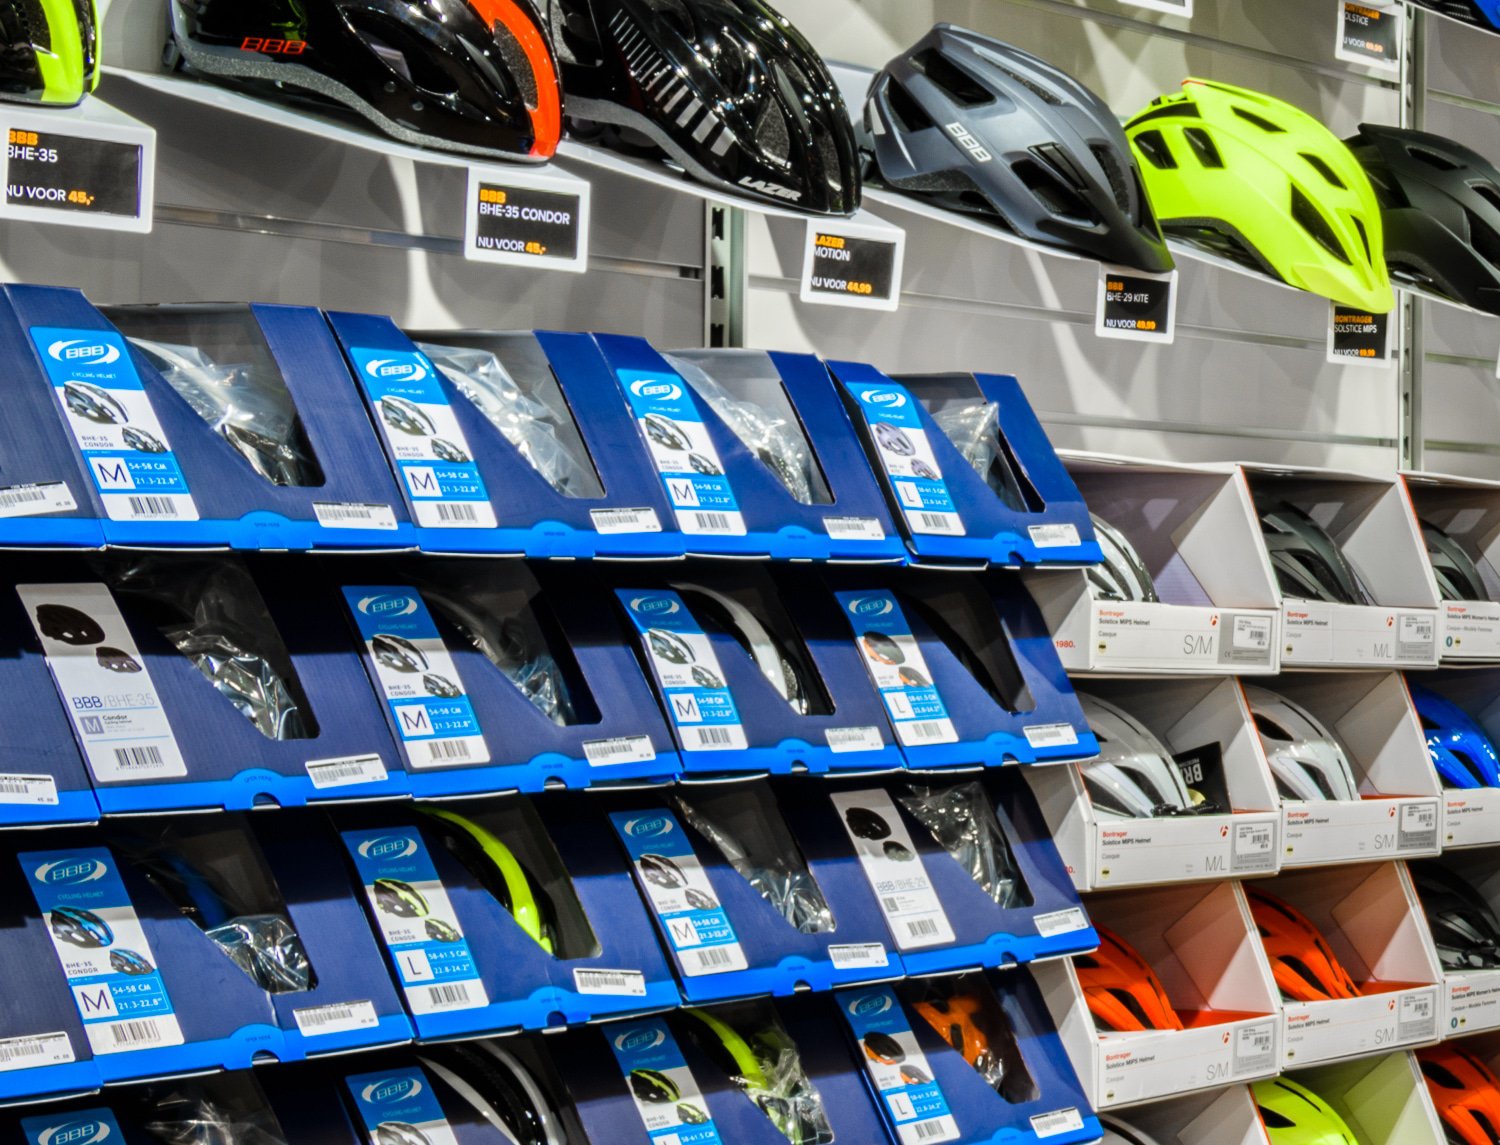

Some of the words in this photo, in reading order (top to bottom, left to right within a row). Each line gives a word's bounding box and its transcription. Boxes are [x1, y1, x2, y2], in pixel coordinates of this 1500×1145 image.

[241, 37, 307, 55] BBB
[1349, 38, 1365, 48] VOOR
[945, 122, 992, 163] BBB
[8, 145, 58, 163] BHE-35
[6, 185, 23, 197] NU
[27, 187, 66, 201] VOOR
[68, 191, 94, 206] 45,-
[738, 176, 801, 201] LAZER
[480, 189, 506, 204] BBB
[479, 202, 519, 219] BHE-35
[521, 208, 570, 224] CONDOR
[478, 237, 493, 248] NU
[495, 239, 525, 251] VOOR
[815, 235, 844, 249] LAZER
[814, 247, 850, 261] MOTION
[823, 278, 846, 290] VOOR
[1107, 282, 1124, 290] BBB
[1106, 293, 1132, 302] BHE-29
[1134, 294, 1149, 303] KITE
[1106, 319, 1116, 327] NU
[1117, 320, 1136, 328] VOOR
[1335, 324, 1362, 333] SOLSTICE
[1363, 325, 1377, 333] MIPS
[66, 345, 104, 359] BBB
[381, 364, 412, 376] BBB
[643, 385, 670, 395] BBB
[872, 394, 896, 402] BBB
[98, 463, 127, 483] M
[410, 472, 435, 491] M
[672, 483, 694, 501] M
[903, 486, 915, 502] L
[372, 599, 404, 613] BBB
[643, 599, 668, 611] BBB
[860, 600, 883, 612] BBB
[1055, 640, 1076, 649] 1980.
[1183, 635, 1213, 654] S/M
[1374, 643, 1392, 658] M/L
[429, 707, 449, 715] 54-58
[676, 699, 697, 717] M
[893, 698, 905, 713] L
[85, 721, 98, 734] M
[402, 711, 427, 730] M
[636, 820, 663, 833] BBB
[373, 840, 404, 856] BBB
[1102, 838, 1121, 846] Solstice
[1375, 834, 1395, 850] S/M
[1205, 856, 1227, 872] M/L
[53, 863, 91, 881] BBB
[673, 922, 694, 941] M
[68, 967, 98, 975] CONDOR
[407, 956, 422, 975] L
[112, 986, 136, 995] 54-58
[138, 984, 151, 992] CM
[81, 989, 110, 1012] M
[1287, 1014, 1310, 1023] Bontrager
[627, 1031, 654, 1048] BBB
[1375, 1027, 1395, 1044] S/M
[1105, 1051, 1132, 1062] Bontrager
[1106, 1060, 1125, 1070] Solstice
[1125, 1058, 1138, 1067] MIPS
[1139, 1055, 1155, 1064] Helmet
[1206, 1061, 1229, 1081] S/M
[376, 1079, 409, 1099] BBB
[895, 1099, 907, 1115] L
[55, 1123, 95, 1145] BBB
